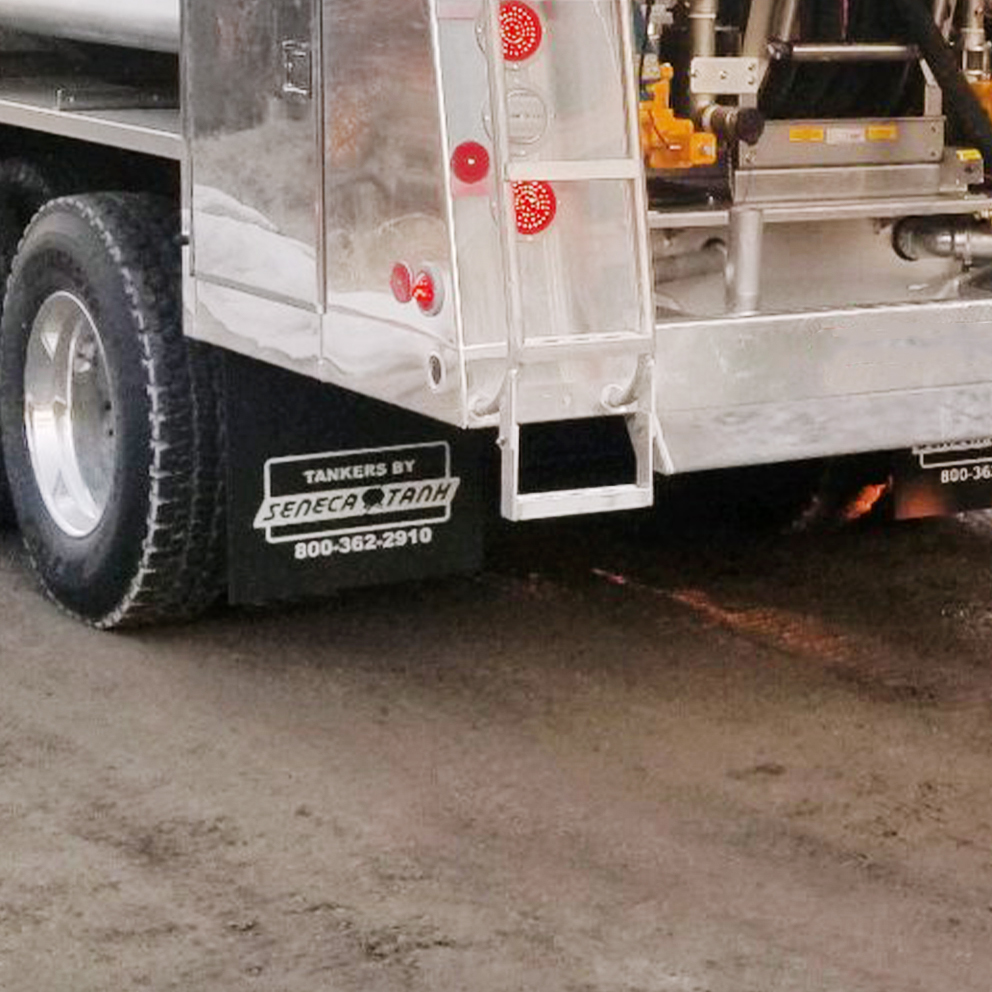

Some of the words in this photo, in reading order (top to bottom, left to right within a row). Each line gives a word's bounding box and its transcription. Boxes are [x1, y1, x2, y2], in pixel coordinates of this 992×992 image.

[303, 464, 387, 484] TANKERS
[391, 460, 416, 474] BY
[264, 493, 358, 521] SENECA
[294, 527, 433, 559] 800-362-2910
